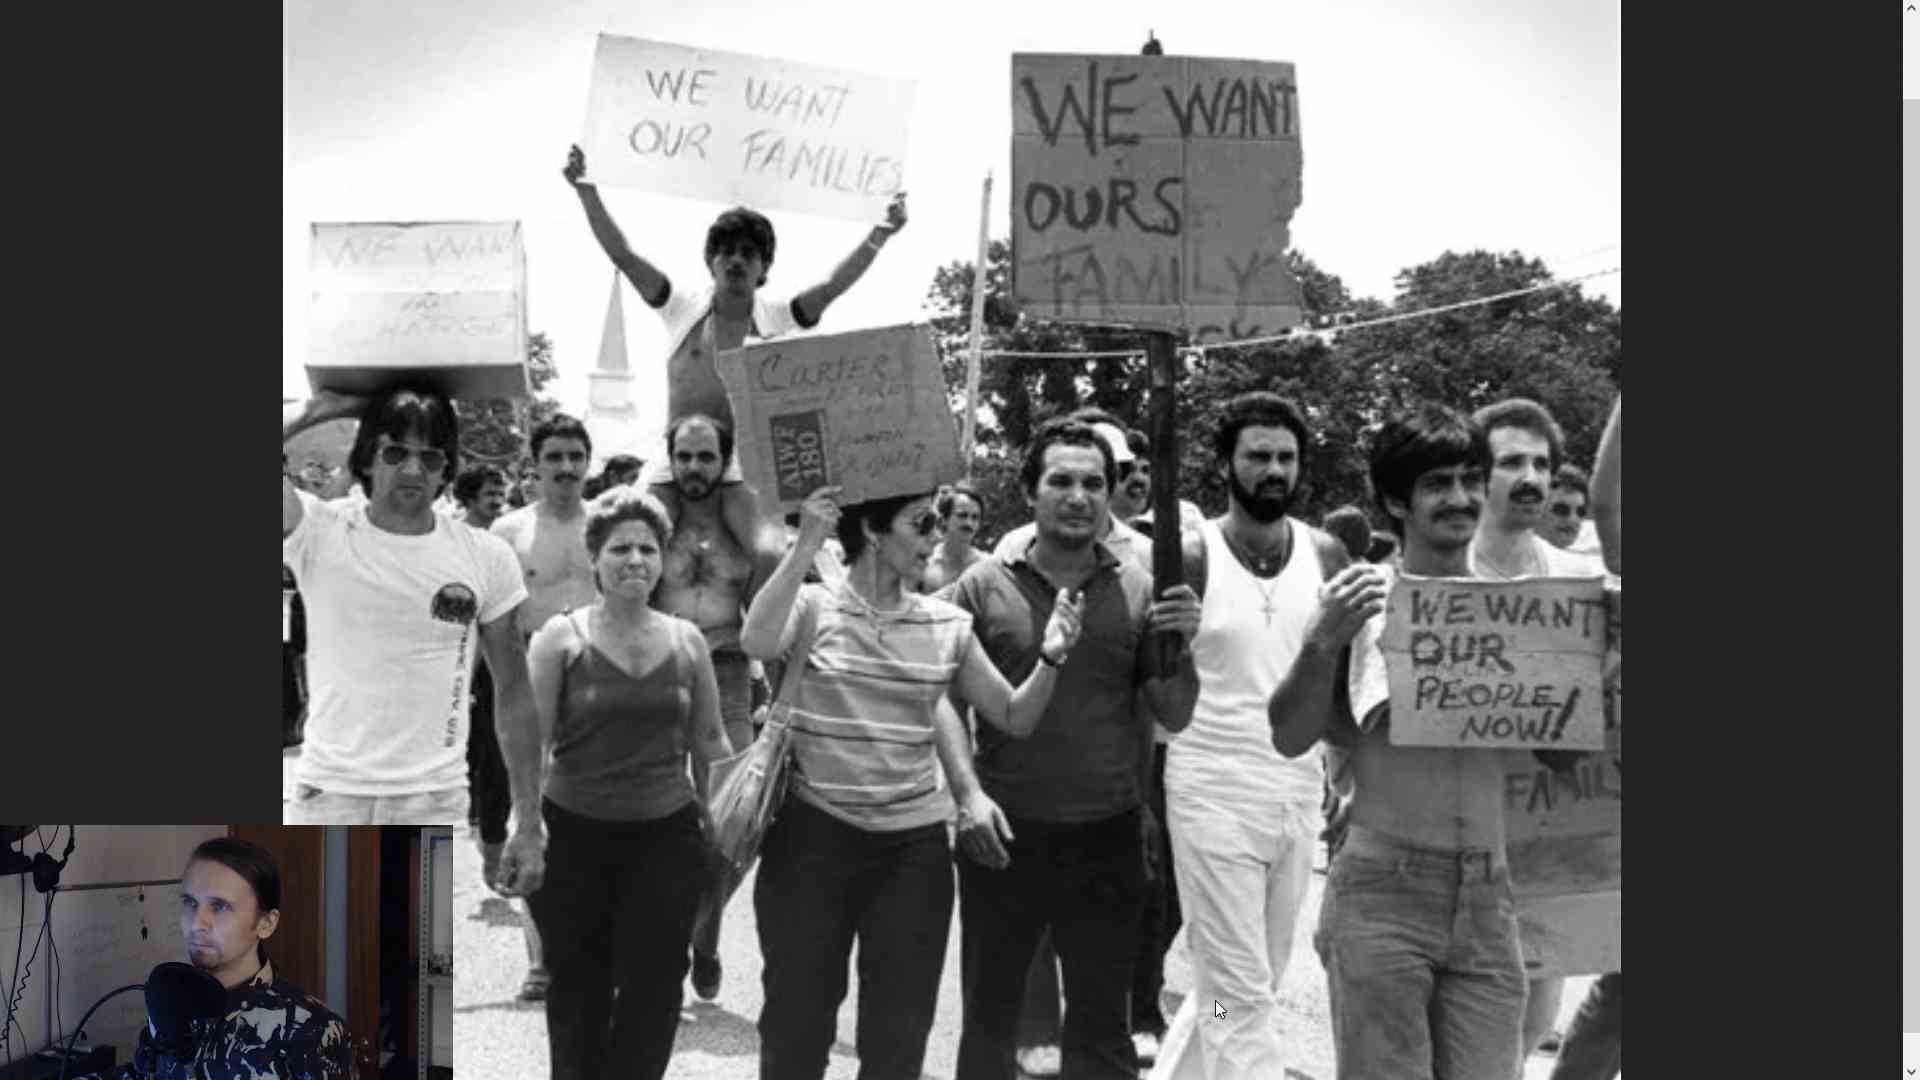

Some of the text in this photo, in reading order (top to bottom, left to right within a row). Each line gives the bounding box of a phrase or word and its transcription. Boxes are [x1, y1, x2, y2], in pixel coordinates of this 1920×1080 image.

[646, 68, 849, 126] WE WANT
[1021, 61, 1297, 156] WE WANT
[629, 120, 904, 196] OUR FAMILIES
[1025, 176, 1184, 235] OURS
[1021, 245, 1284, 318] FAMILY
[1411, 591, 1475, 625] WE
[1485, 594, 1604, 637] WANT
[1411, 632, 1515, 674] OUR
[1416, 676, 1562, 710] PEOPLE
[1459, 687, 1580, 741] NOW!
